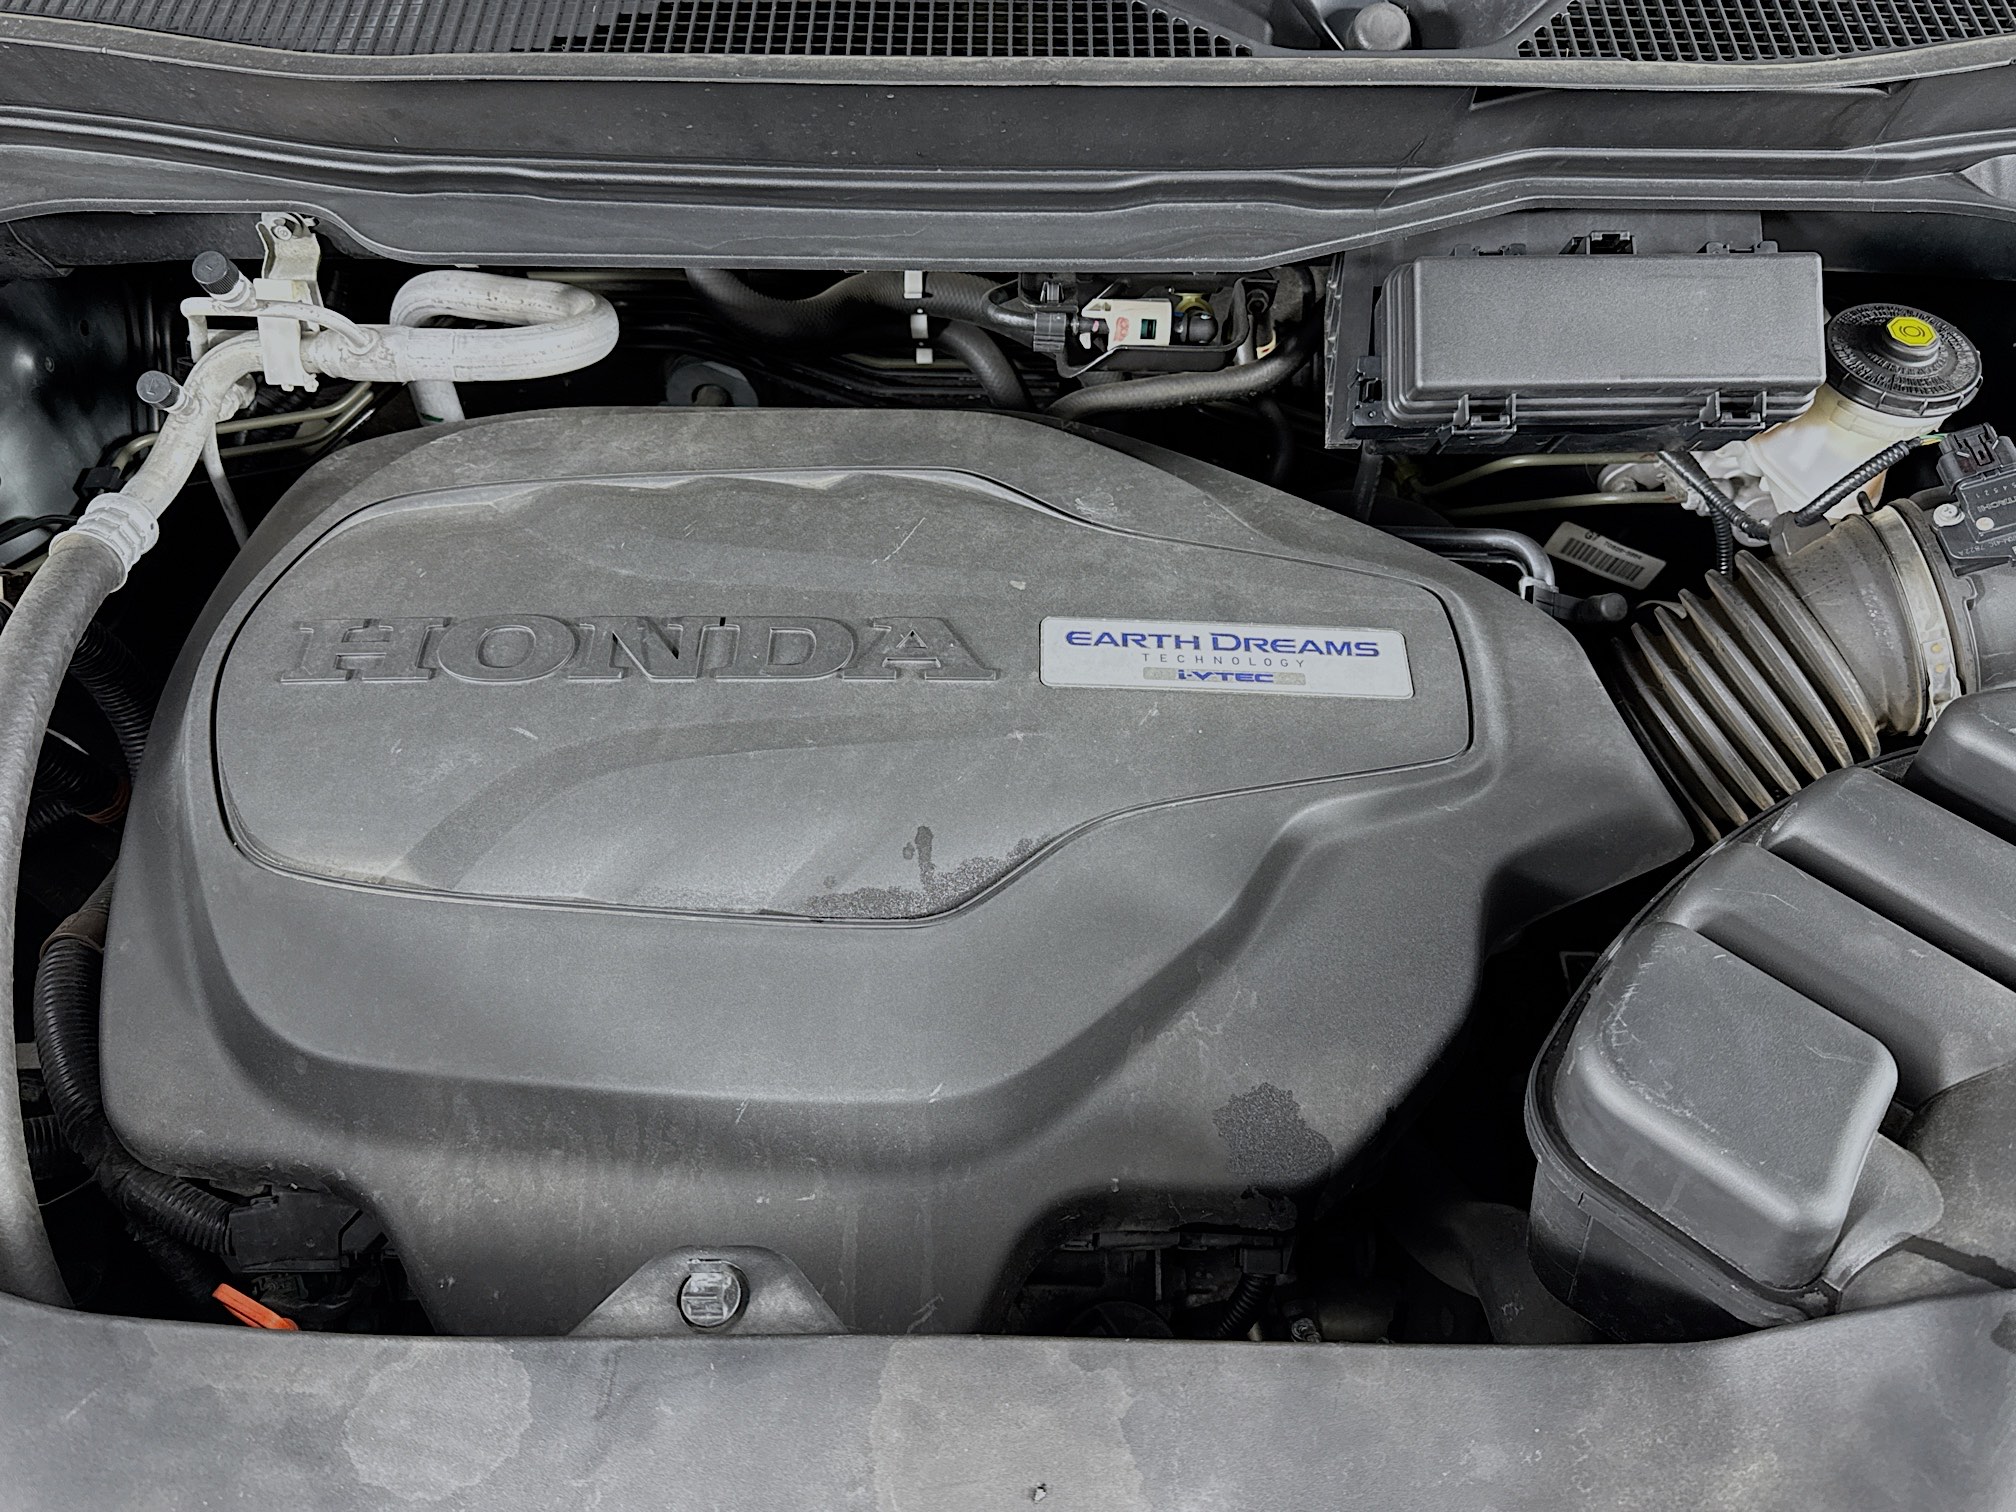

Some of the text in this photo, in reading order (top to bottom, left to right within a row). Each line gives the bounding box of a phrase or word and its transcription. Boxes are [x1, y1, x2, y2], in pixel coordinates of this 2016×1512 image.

[280, 614, 997, 684] HONDA
[1065, 629, 1380, 658] EARTH DREAMS
[1141, 652, 1306, 668] TECHNOLOGY
[1177, 669, 1275, 684] i-VTEC
